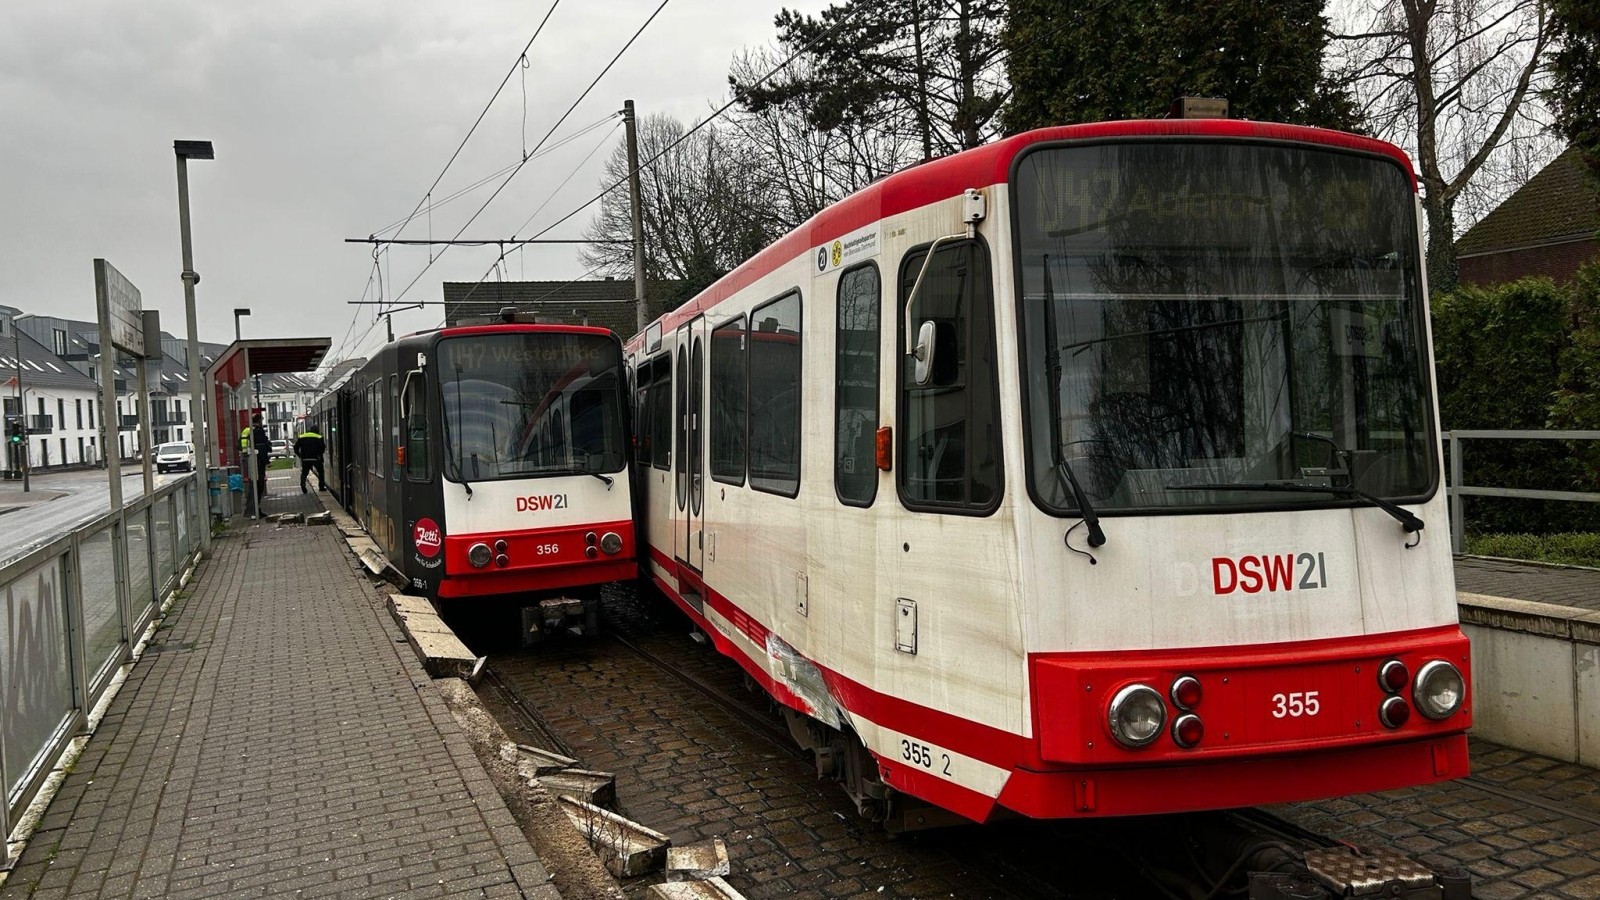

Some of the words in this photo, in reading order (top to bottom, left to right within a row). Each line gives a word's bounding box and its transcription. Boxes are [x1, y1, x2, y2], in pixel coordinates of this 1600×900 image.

[1037, 168, 1119, 233] U47
[449, 343, 486, 369] U47
[516, 494, 568, 511] DSW21
[536, 543, 559, 555] 356
[1212, 552, 1327, 595] DSW21
[1271, 690, 1320, 719] 355
[901, 739, 932, 768] 355
[941, 753, 952, 777] 2
